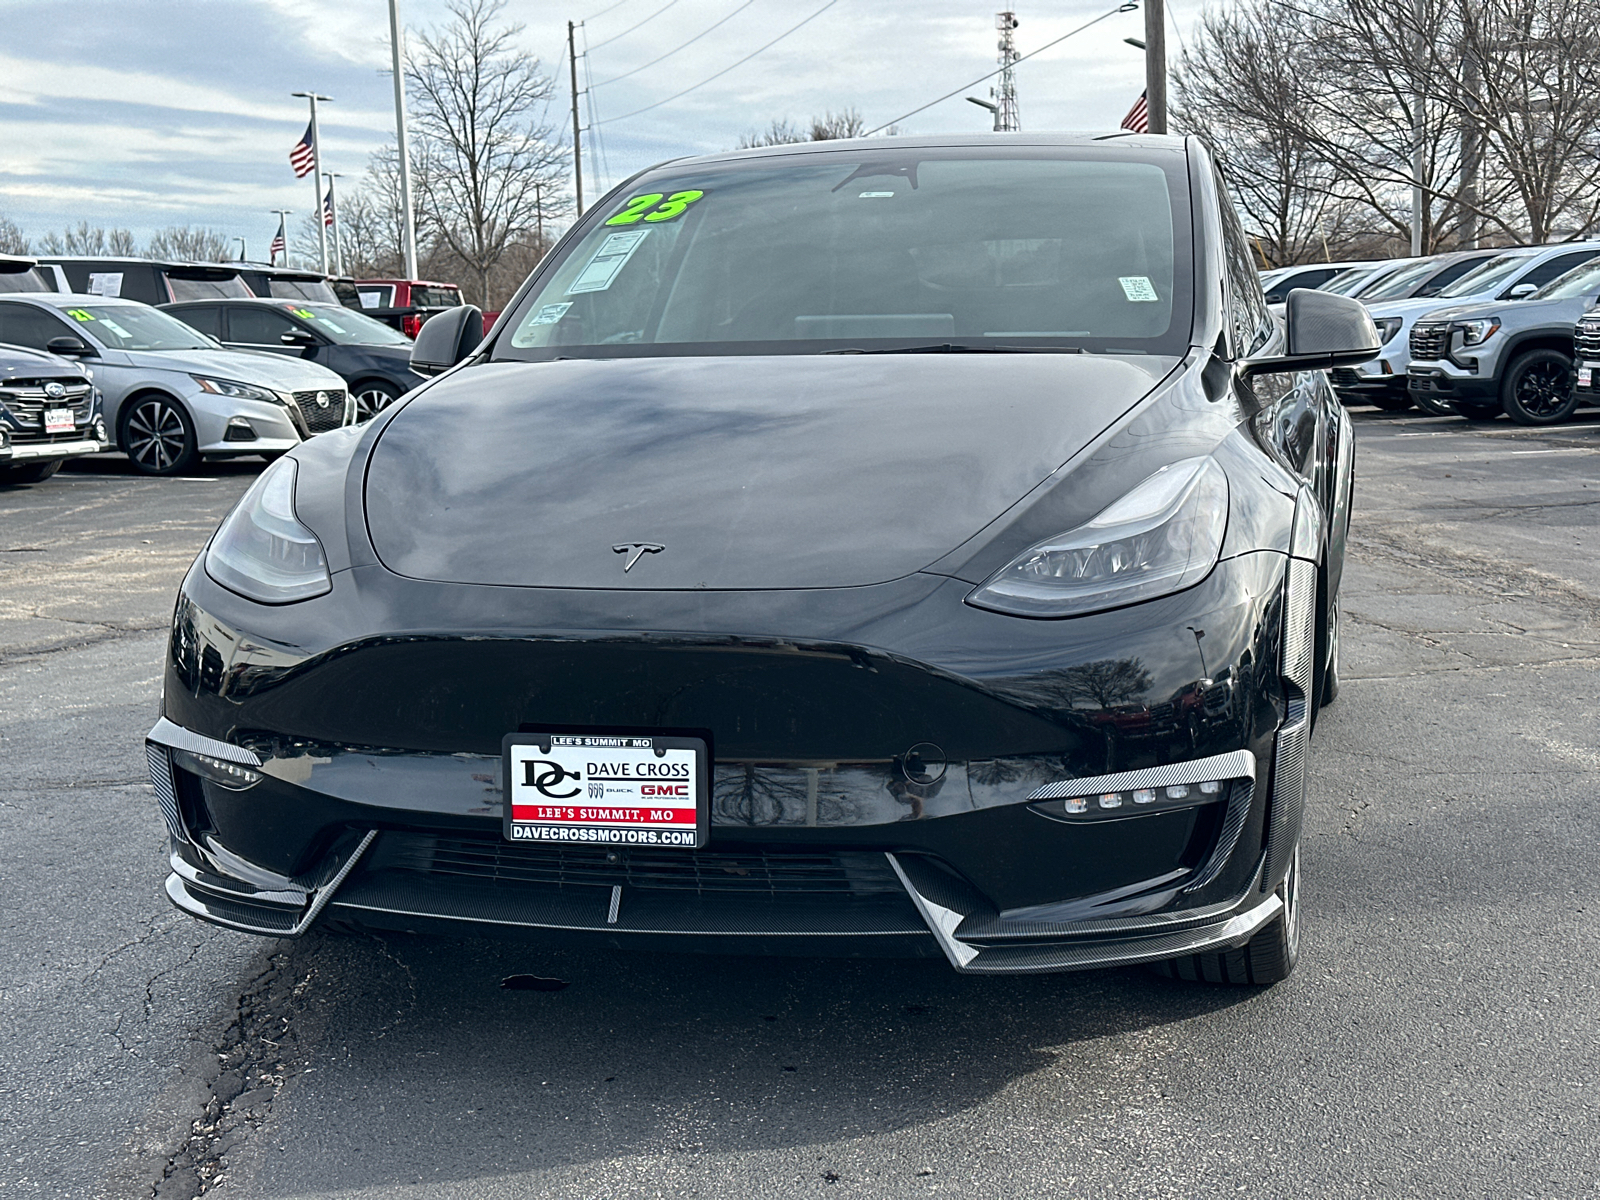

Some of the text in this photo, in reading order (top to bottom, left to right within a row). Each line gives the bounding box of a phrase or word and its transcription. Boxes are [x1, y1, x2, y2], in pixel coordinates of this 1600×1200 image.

[605, 190, 704, 226] 23
[67, 308, 96, 322] 21
[585, 738, 628, 746] SUMMIT
[633, 739, 650, 747] MO
[587, 762, 689, 777] DAVE CROSS
[641, 785, 689, 796] GMC
[580, 809, 644, 821] SUMMIT,
[650, 810, 673, 821] MO
[513, 826, 694, 845] DAVECROSSMOTORS.COM
